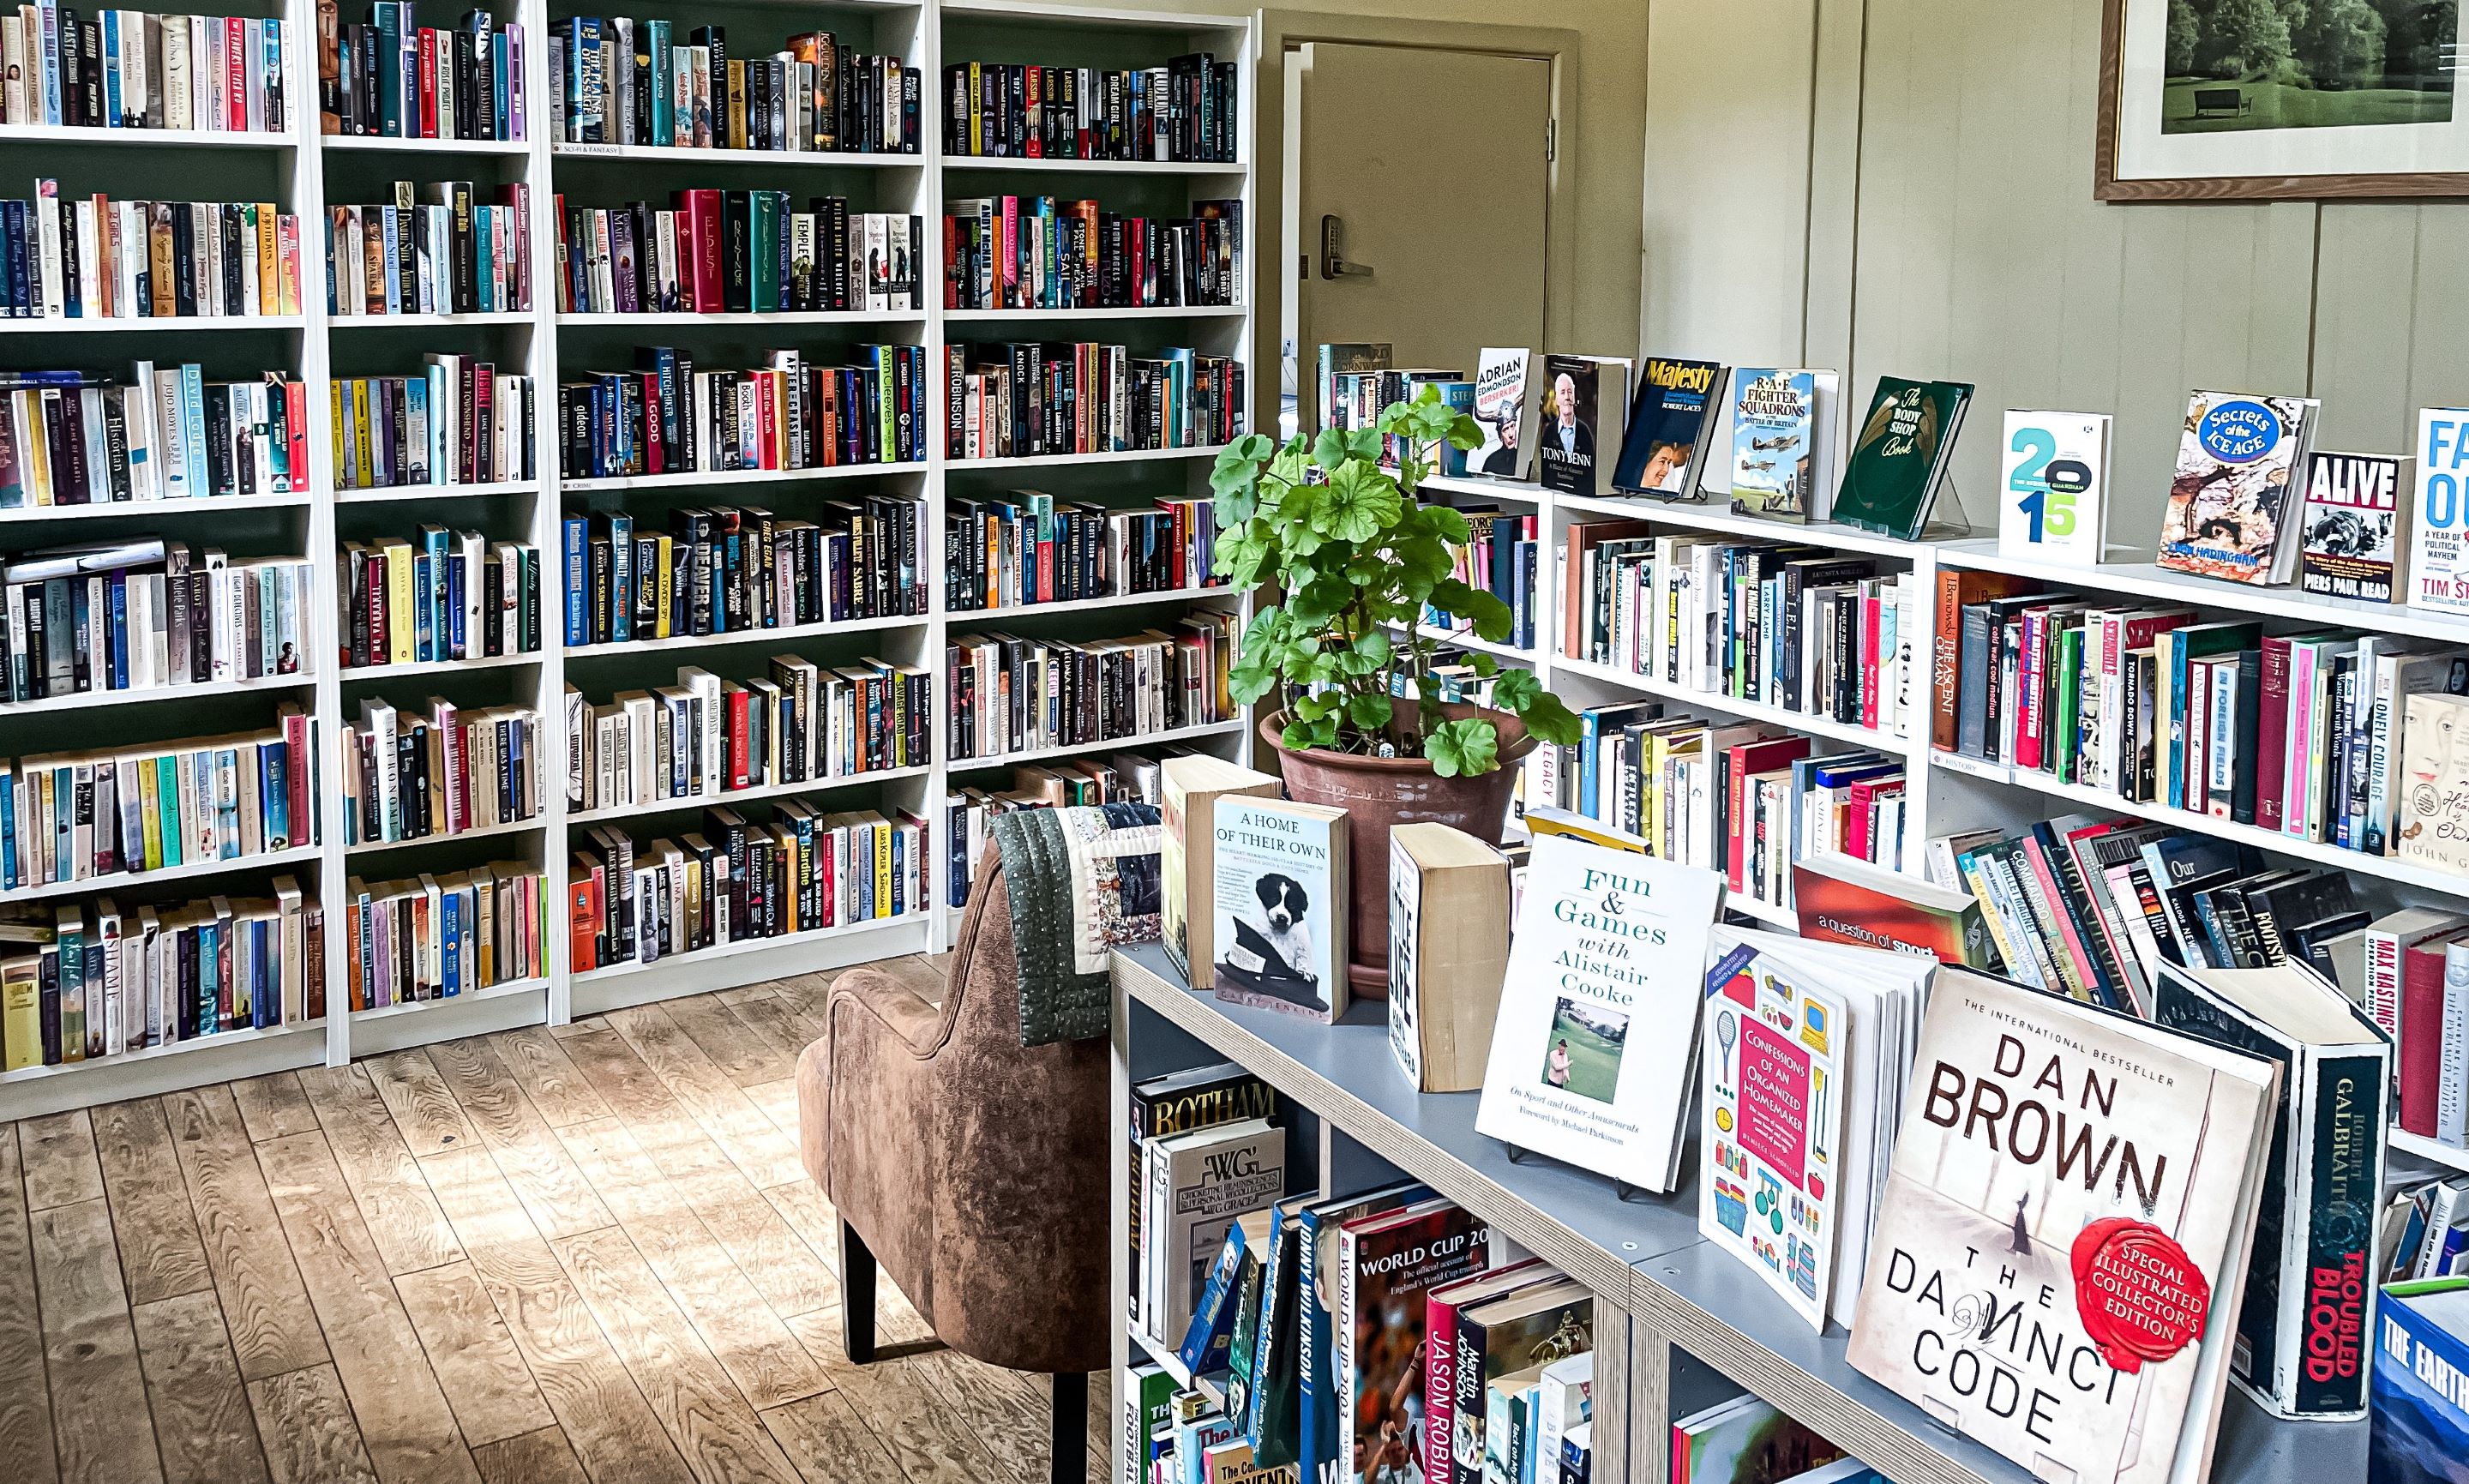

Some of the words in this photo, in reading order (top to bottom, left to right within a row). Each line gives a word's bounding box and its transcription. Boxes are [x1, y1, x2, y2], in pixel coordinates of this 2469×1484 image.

[85, 25, 97, 59] GRIDIRON
[230, 28, 242, 67] LEAVERS
[480, 17, 490, 54] SPIN
[441, 66, 450, 86] ROSIE
[1030, 69, 1038, 101] LARSSON
[1110, 75, 1120, 105] DREAM
[441, 87, 451, 111] PROJECT
[1155, 71, 1168, 117] LUDLUM
[1110, 106, 1120, 124] GIRL
[981, 204, 991, 229] ANDY
[705, 216, 714, 279] ELDEST
[734, 220, 742, 286] BRISINGR
[797, 219, 809, 259] TEMPLE
[1060, 253, 1071, 280] SAIL
[881, 348, 891, 376] Ann
[1333, 348, 1389, 360] BERNARD
[478, 369, 491, 408] KISMET
[1478, 357, 1521, 386] ADRIAN
[1478, 373, 1522, 397] EDMONDSON
[1647, 360, 1715, 394] Majesty
[164, 384, 174, 405] JOJO
[188, 370, 201, 408] David
[742, 385, 750, 411] Booth
[786, 357, 799, 442] AFTERCRASH
[883, 376, 893, 424] Cleeves
[951, 370, 963, 429] ROBINSON
[1480, 384, 1519, 406] BERSERKER!
[1747, 389, 1798, 405] FIGHTER
[1901, 387, 1921, 409] The
[463, 388, 472, 440] TOWNSHEND
[574, 406, 589, 438] gideon
[649, 405, 658, 442] GOOD
[1661, 401, 1683, 411] ROBERT
[1683, 404, 1703, 412] LACEY
[1739, 400, 1805, 418] SQUADRONS
[1745, 417, 1765, 426] BATTLE
[1774, 419, 1798, 428] BRITAIN
[1893, 407, 1922, 424] BODY
[2209, 409, 2271, 433] Secrets
[167, 408, 177, 440] MOYES
[191, 416, 204, 455] Lodge
[1889, 421, 1917, 436] SHOP
[108, 418, 123, 472] Historian
[1541, 447, 1567, 463] TONY
[1567, 452, 1591, 467] BENN
[1881, 436, 1913, 457] Book
[2207, 430, 2231, 454] ICE
[2232, 436, 2266, 455] AGE
[2309, 456, 2396, 508] ALIVE
[617, 530, 628, 546] JOHN
[763, 520, 772, 543] GREG
[1025, 528, 1035, 554] GHOST
[2425, 540, 2460, 551] POLITICAL
[2431, 531, 2449, 540] YEAR
[2452, 532, 2460, 541] OF
[764, 545, 773, 568] EGAN
[2428, 550, 2458, 561] MAYHEM
[173, 579, 186, 604] Adele
[694, 544, 710, 605] DEAVER
[853, 568, 863, 604] SABRE
[2304, 573, 2331, 595] PIERS
[2333, 576, 2359, 598] PAUL
[2361, 580, 2391, 601] READ
[2422, 579, 2448, 597] TIM
[174, 604, 186, 628] Parks
[233, 593, 243, 628] DETECTIVES
[1944, 638, 1955, 662] THE
[1935, 653, 1945, 687] MAN
[2127, 661, 2136, 703] TORNADO
[895, 681, 904, 710] SAVAGE
[1941, 664, 1955, 716] ASCENT
[869, 713, 880, 742] Munich
[896, 712, 904, 734] ROAD
[2126, 705, 2135, 736] DOWN
[2374, 696, 2388, 742] LONELY
[386, 728, 399, 829] METRONOME
[1542, 741, 1553, 797] LEGACY
[1945, 758, 1977, 773] HISTORY
[2215, 744, 2226, 785] FIELDS
[2370, 743, 2385, 802] COURAGE
[1241, 813, 1252, 826] A
[1254, 814, 1300, 835] HOME
[1216, 828, 1235, 842] OF
[1238, 832, 1285, 853] THEIR
[1289, 842, 1326, 860] OWN
[2406, 844, 2448, 862] JOHN
[673, 860, 682, 903] ULTIMA
[1580, 868, 1651, 898] Fun
[2012, 850, 2050, 920] COMMANDO
[2171, 860, 2196, 878] Our
[1601, 891, 1625, 916] &
[2015, 898, 2037, 934] MAGNET
[1554, 898, 1667, 946] Games
[1818, 916, 1827, 927] a
[1829, 918, 1876, 946] question
[1879, 934, 1890, 947] of
[1577, 934, 1631, 961] with
[2376, 940, 2395, 970] MAX
[106, 939, 121, 1003] SHAME
[1553, 949, 1649, 987] Alistair
[1561, 973, 1634, 1007] Cooke
[1964, 998, 1985, 1014] THE
[1991, 1009, 2086, 1054] INTERNATIONAL
[2093, 1048, 2175, 1089] BESTSELLER
[1775, 1066, 1790, 1084] AN
[1993, 1033, 2118, 1120] DAN
[1154, 1084, 1276, 1135] BOTHAM
[1523, 1090, 1546, 1104] Sport
[1565, 1102, 1588, 1116] Other
[1589, 1111, 1640, 1133] Amusements
[1923, 1060, 2167, 1221] BROWN
[1300, 1219, 1313, 1280] JONNY
[1361, 1247, 1426, 1277] WORLD
[1431, 1235, 1464, 1258] CUP
[2121, 1245, 2186, 1287] SPECIAL
[1340, 1259, 1349, 1325] WORLD
[1391, 1278, 1422, 1295] England's
[1424, 1271, 1444, 1285] World
[1459, 1261, 1484, 1275] triumph
[1966, 1246, 2055, 1309] THE
[2094, 1253, 2203, 1314] ILLUSTRATED
[2092, 1271, 2199, 1334] COLLECTOR'S
[2336, 1248, 2366, 1379] TROUBLED
[1300, 1285, 1313, 1384] WILKINSON
[1886, 1247, 1945, 1317] DA
[1978, 1289, 2118, 1405] VINCI
[2105, 1297, 2176, 1343] EDITION
[2306, 1266, 2341, 1384] BLOOD
[1340, 1331, 1349, 1368] CUP
[2382, 1312, 2411, 1370] THE
[1432, 1331, 1451, 1409] JASON
[1455, 1329, 1469, 1406] JOHNSON
[1466, 1346, 1480, 1400] Martin
[1340, 1373, 1349, 1419] 2003
[1913, 1329, 2061, 1445] CODE
[1222, 1466, 1239, 1480] The
